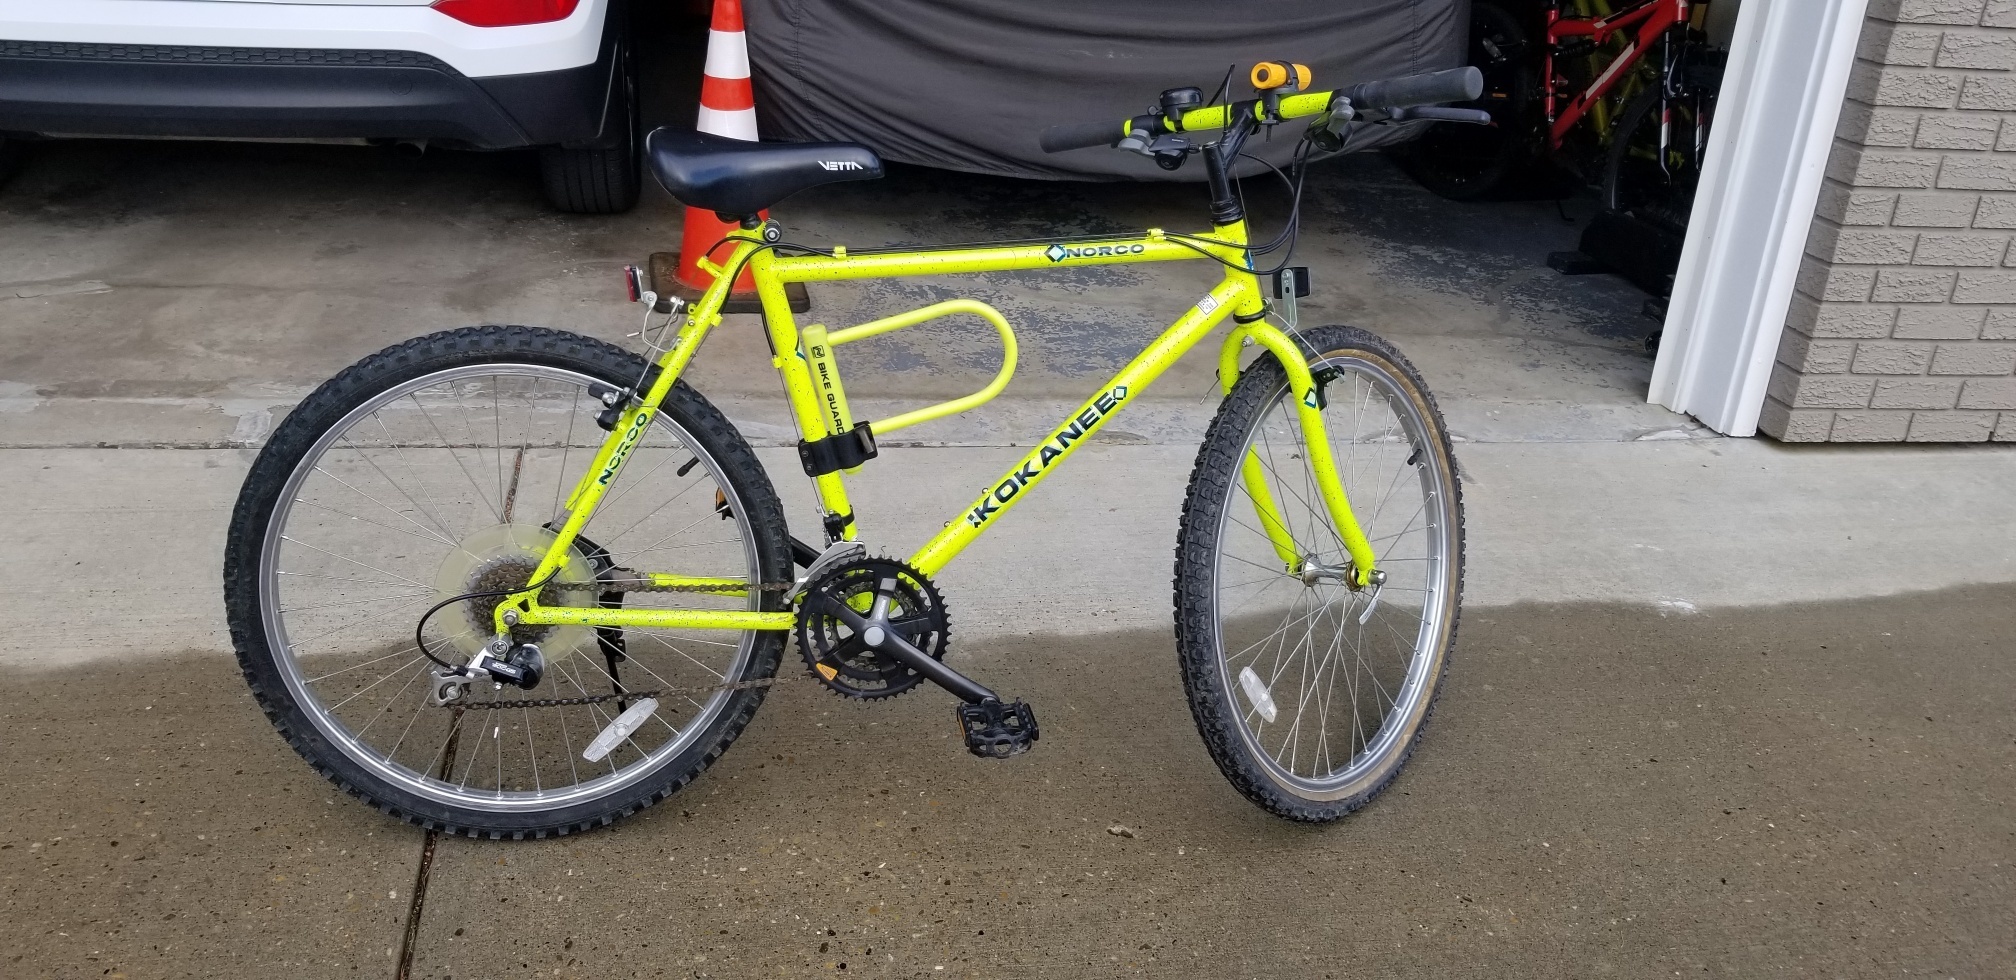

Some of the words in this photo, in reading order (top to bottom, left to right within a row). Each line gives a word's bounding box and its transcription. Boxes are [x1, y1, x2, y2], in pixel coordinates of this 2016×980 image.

[817, 160, 864, 171] VETTA
[1066, 244, 1145, 258] NORCO
[818, 362, 832, 390] BIKE
[827, 393, 846, 435] GUARD
[599, 413, 648, 486] NORCO
[974, 391, 1118, 523] KOKANEE
